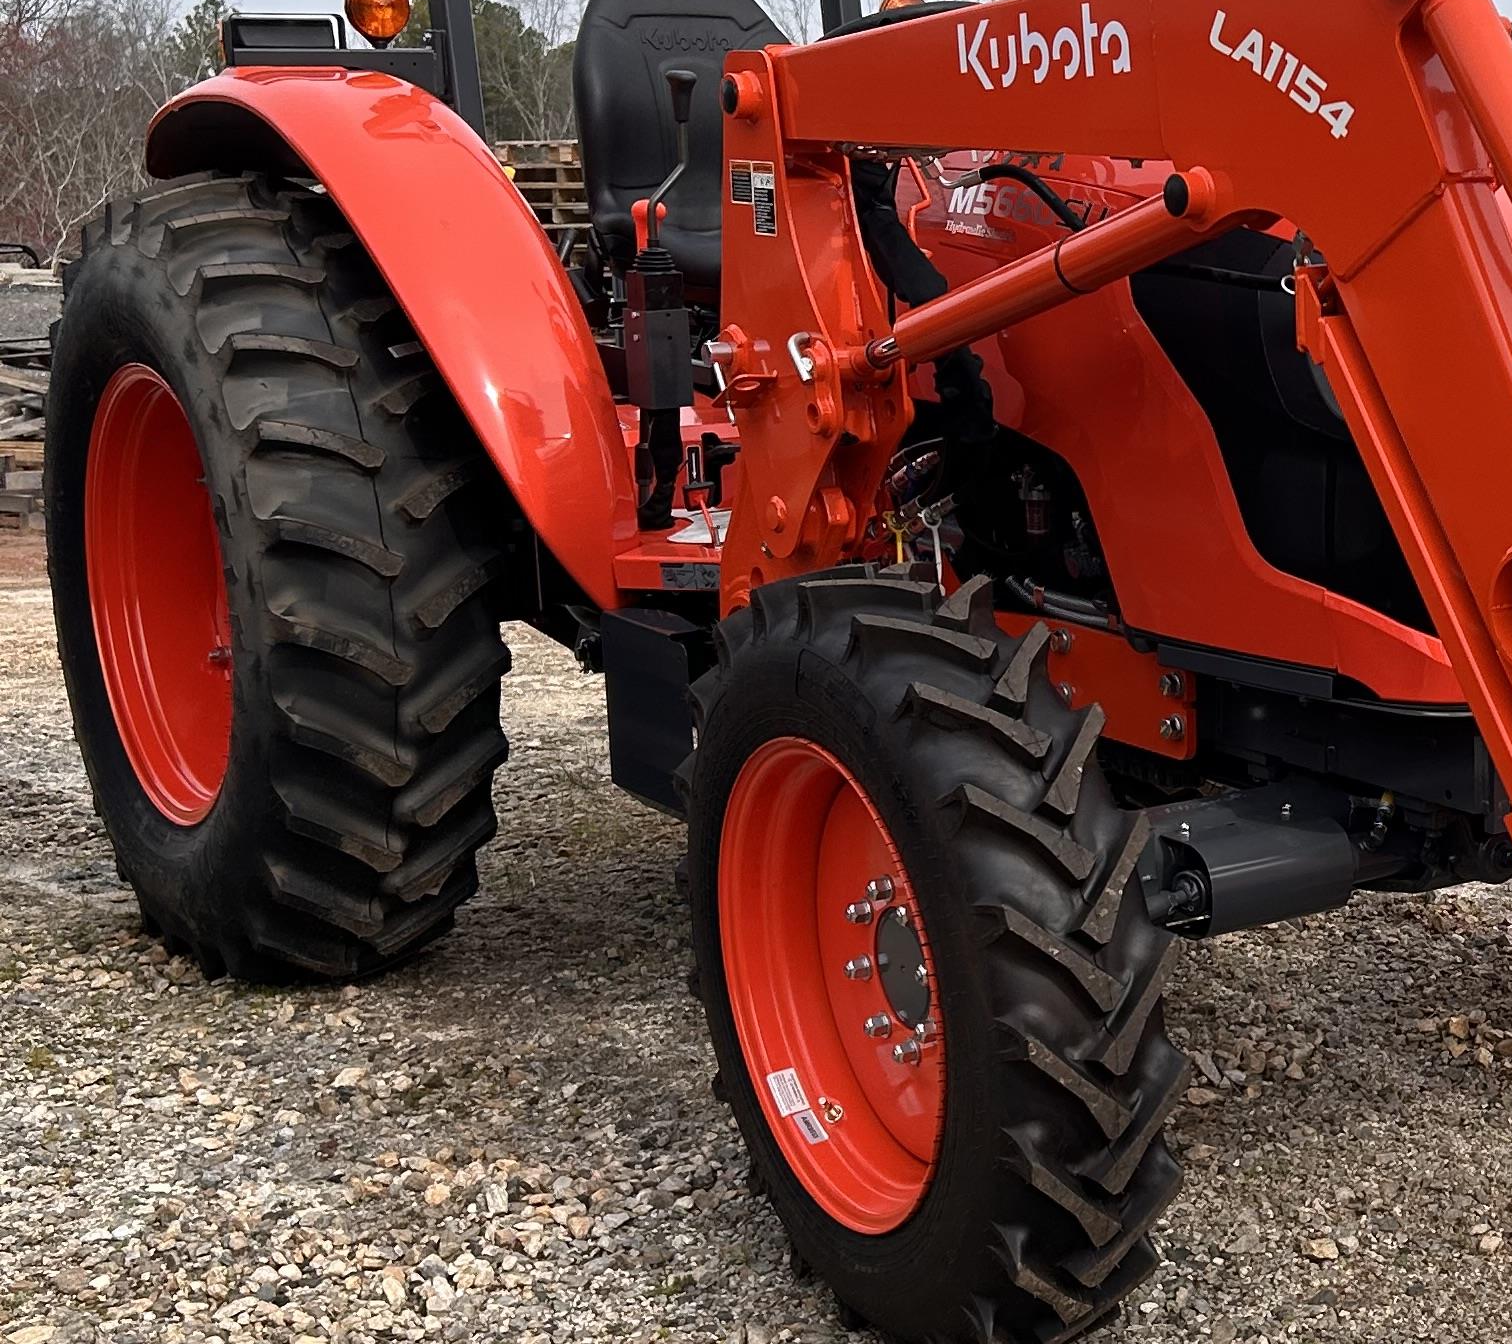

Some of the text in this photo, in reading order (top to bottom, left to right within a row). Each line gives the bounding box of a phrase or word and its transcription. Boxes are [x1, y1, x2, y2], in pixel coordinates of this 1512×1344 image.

[641, 27, 733, 51] Kubota
[957, 2, 1131, 90] Kubota
[1209, 9, 1355, 140] LA1154
